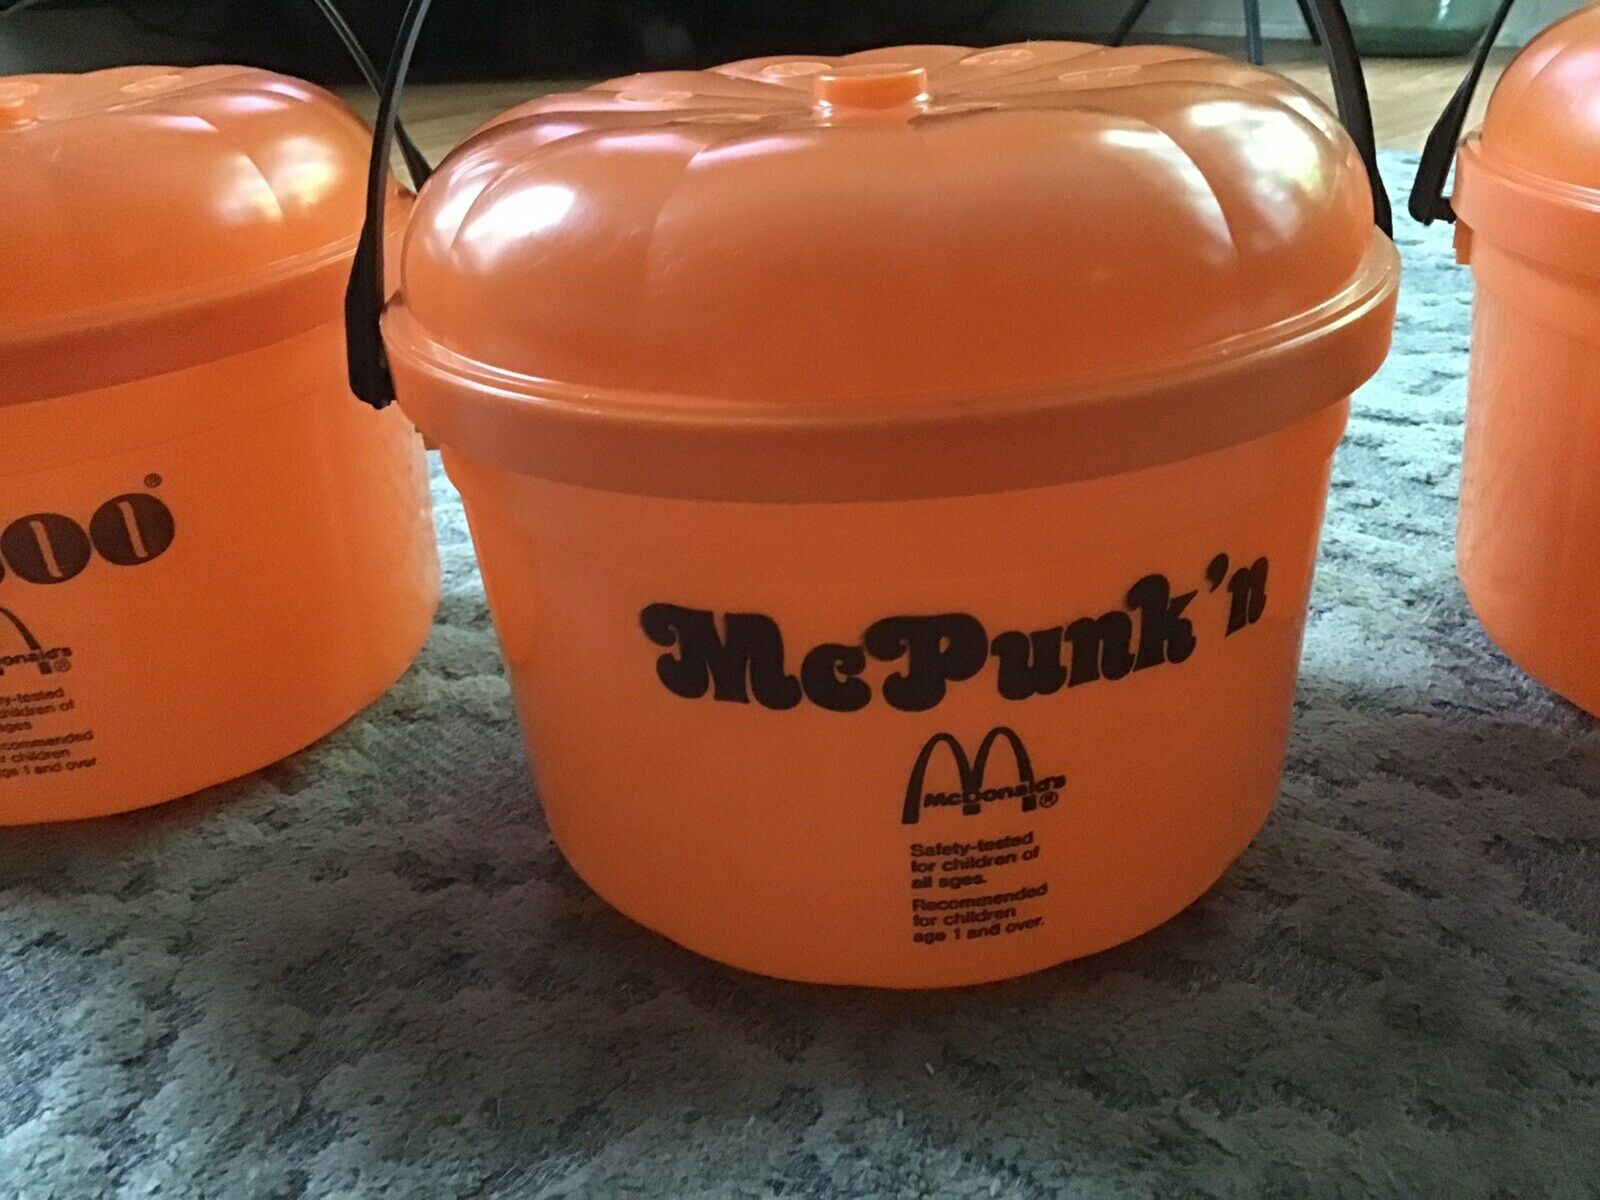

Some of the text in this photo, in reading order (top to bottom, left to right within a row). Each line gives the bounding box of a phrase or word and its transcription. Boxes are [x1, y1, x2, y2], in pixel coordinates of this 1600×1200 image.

[0, 493, 176, 584] oo
[640, 553, 1268, 712] McPunk'n
[910, 830, 1033, 857] Safety-tested
[911, 845, 1040, 873] for children of
[911, 874, 987, 890] all ages.
[912, 882, 1048, 911] Recommended
[913, 907, 1017, 927] for children
[913, 931, 946, 945] age
[953, 927, 961, 940] 1
[967, 924, 1001, 939] and
